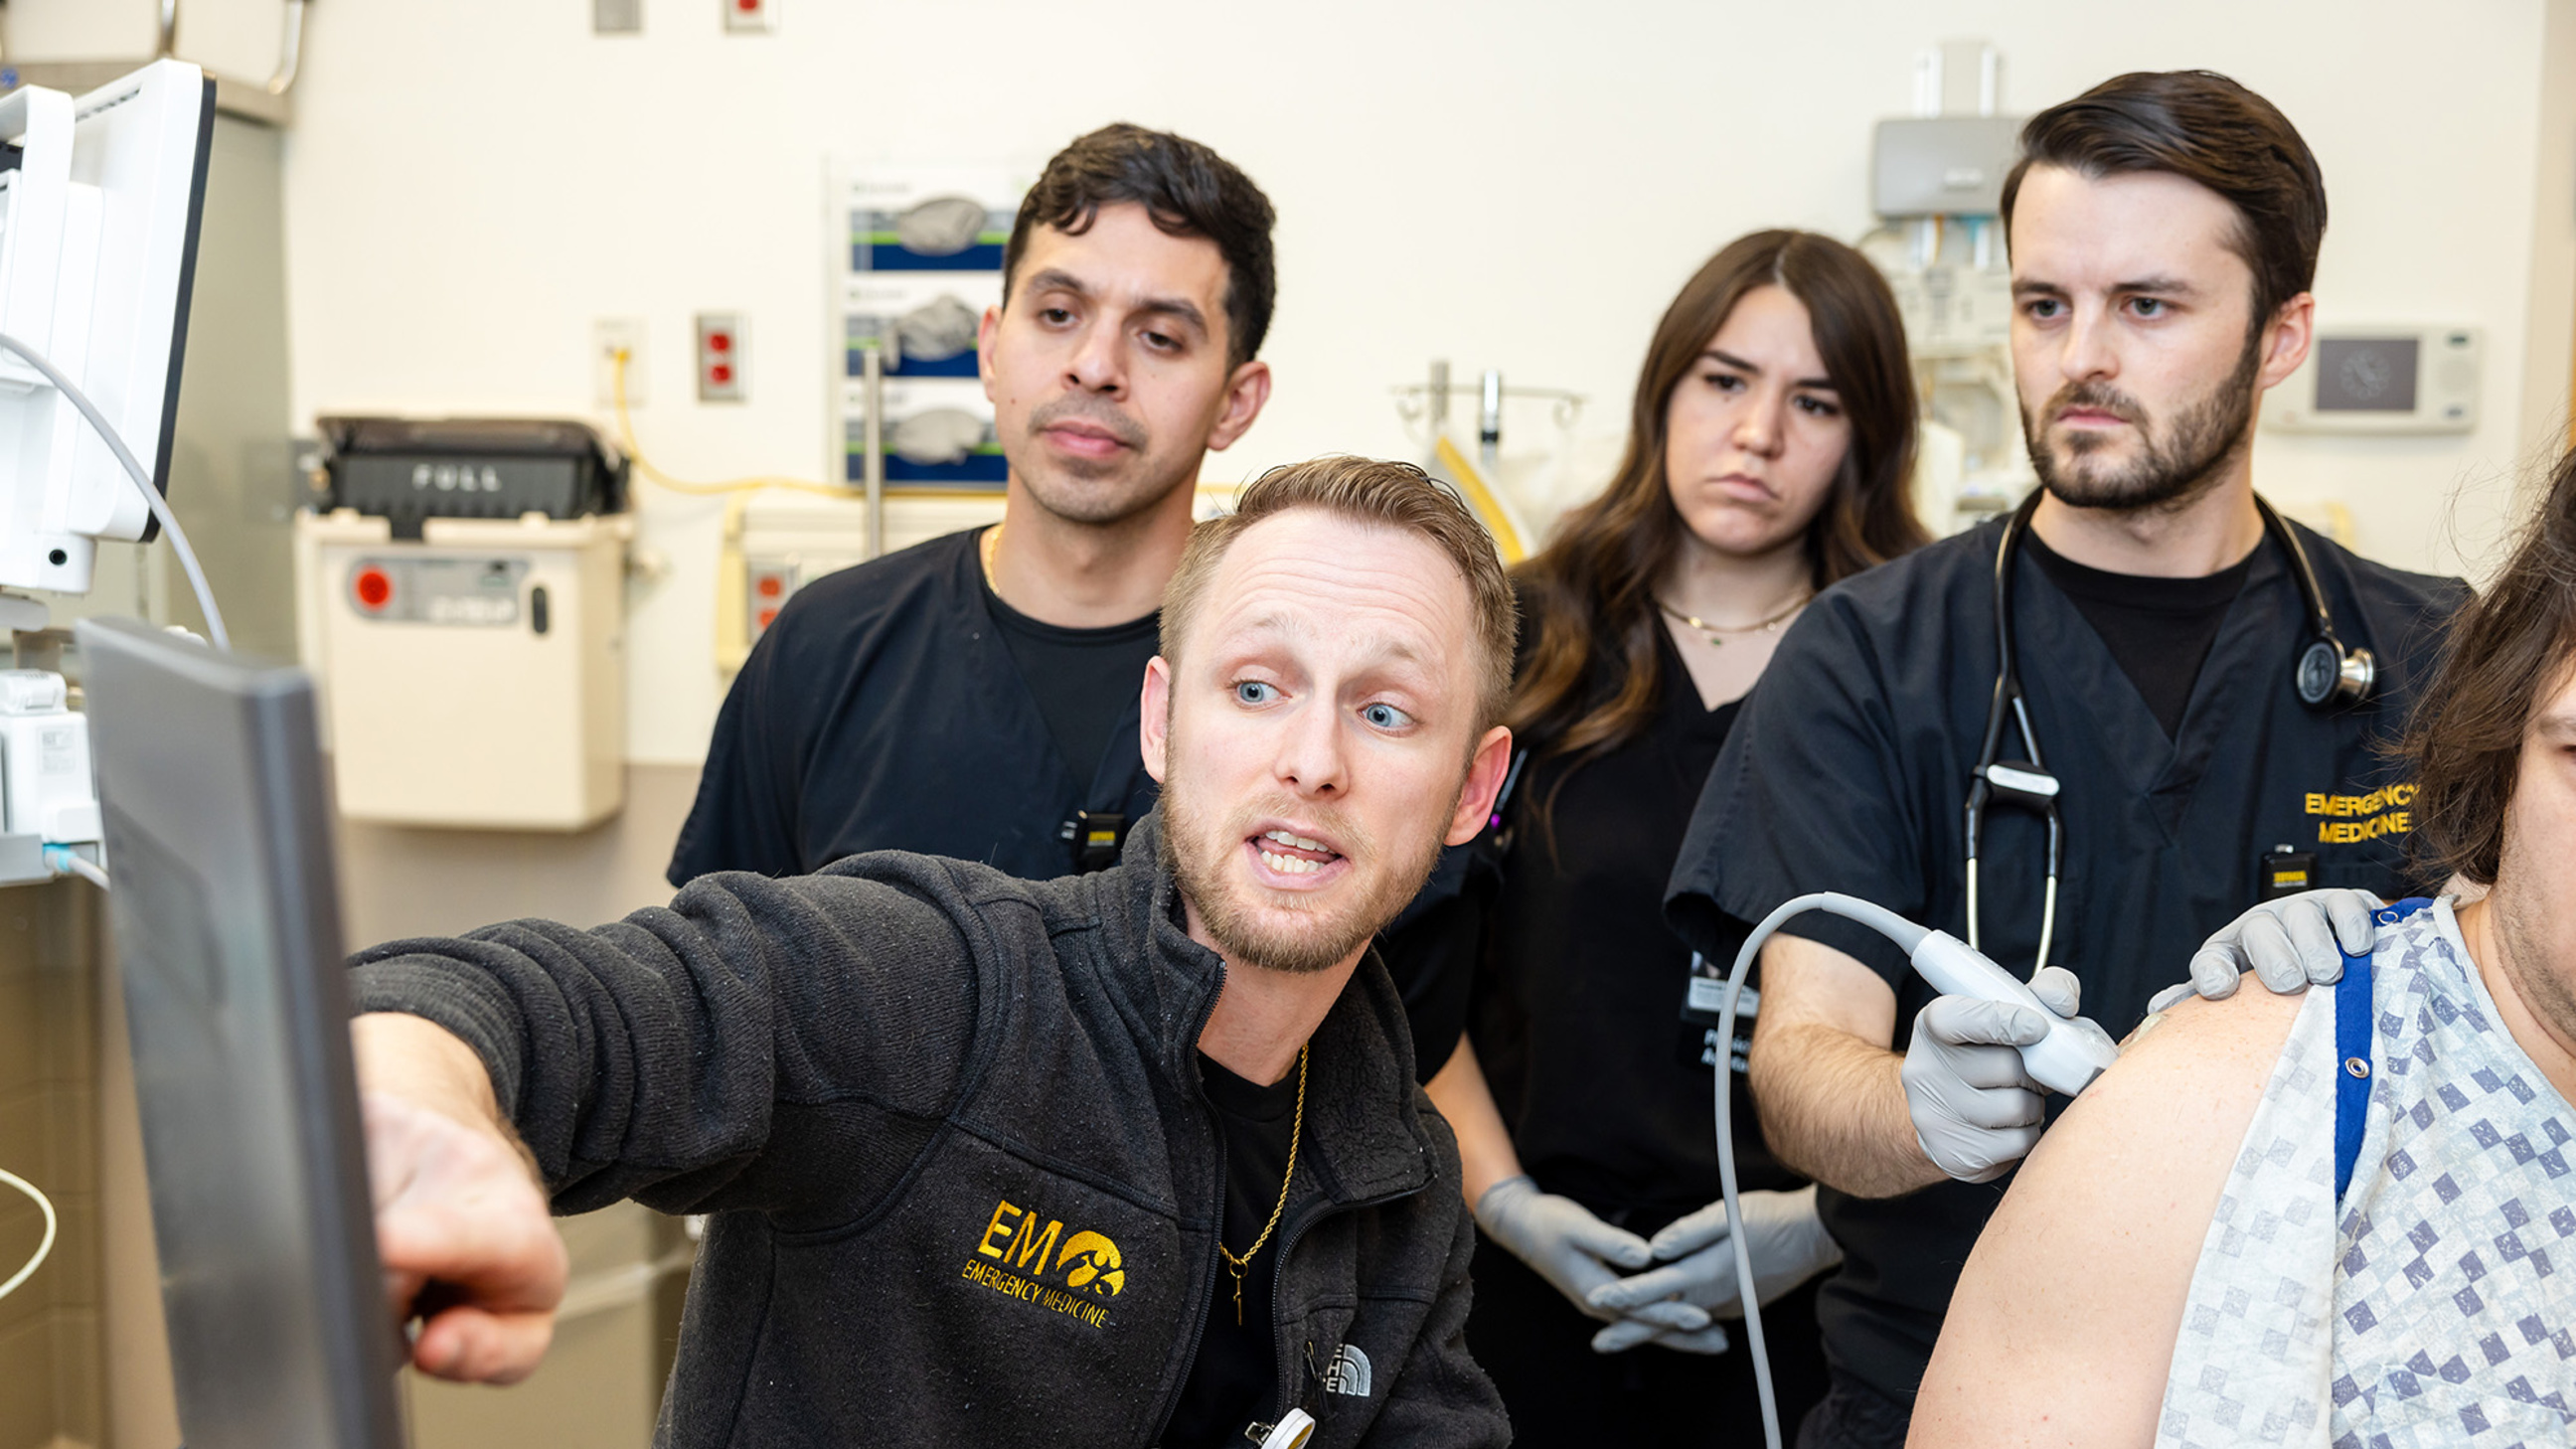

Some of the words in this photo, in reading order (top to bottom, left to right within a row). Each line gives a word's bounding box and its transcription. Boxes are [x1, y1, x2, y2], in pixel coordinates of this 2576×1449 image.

[410, 462, 503, 493] FULL
[977, 1199, 1064, 1276] EM
[961, 1258, 1044, 1304] EMERGENCY
[1042, 1288, 1110, 1329] MEDICINE
